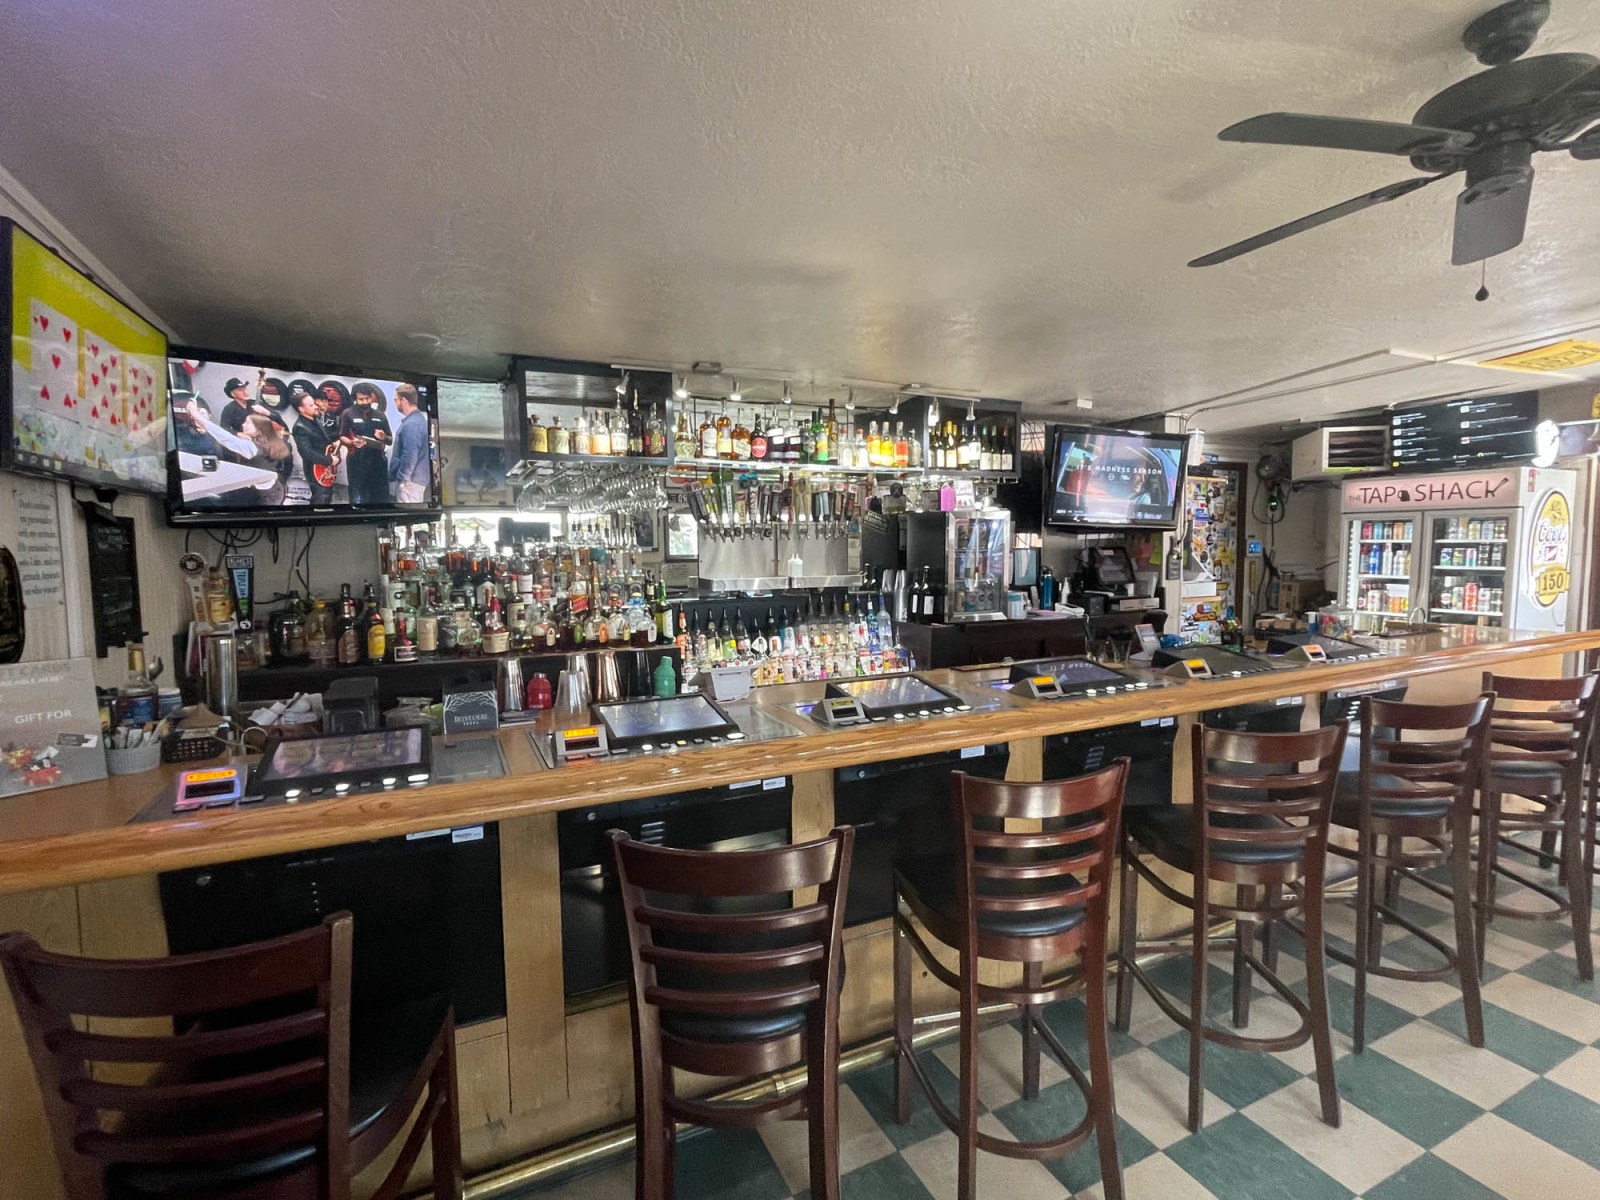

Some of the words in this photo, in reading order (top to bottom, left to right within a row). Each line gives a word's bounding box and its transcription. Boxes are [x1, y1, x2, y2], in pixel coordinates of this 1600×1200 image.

[1095, 465, 1130, 473] MADNESS
[1133, 467, 1162, 475] SEASON
[1348, 494, 1361, 502] THE
[1359, 486, 1396, 503] TAP
[1414, 477, 1509, 502] SHACK
[1542, 572, 1564, 591] 150
[14, 712, 44, 724] GIFT
[47, 708, 72, 720] FOR
[454, 713, 488, 723] BELVEDERE
